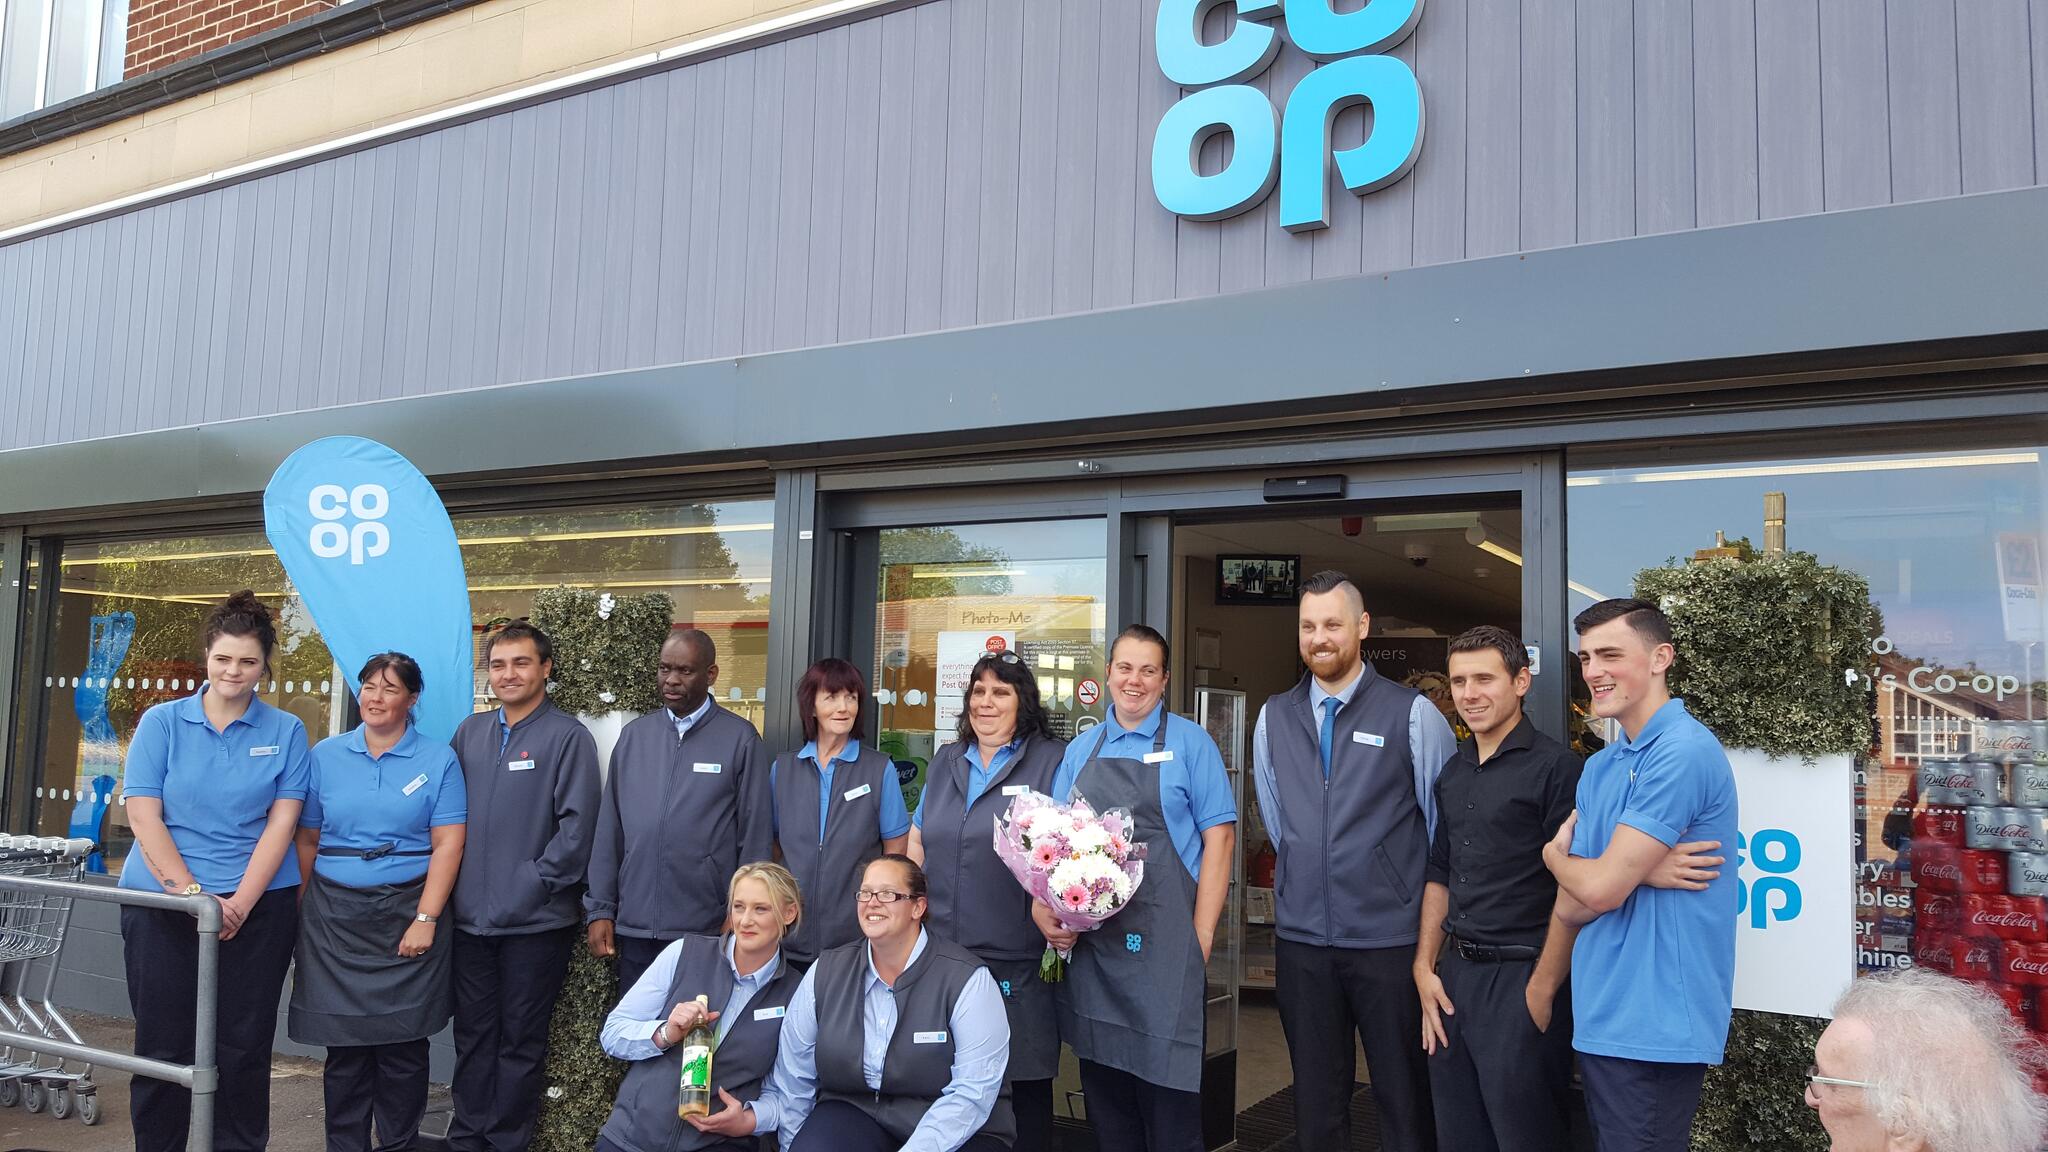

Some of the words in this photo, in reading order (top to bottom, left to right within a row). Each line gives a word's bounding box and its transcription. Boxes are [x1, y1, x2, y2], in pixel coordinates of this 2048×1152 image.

[961, 611, 1032, 625] Photo-Me
[942, 663, 974, 671] everything
[1907, 666, 2020, 702] Co-op
[1924, 773, 1949, 787] Diet
[1946, 774, 1976, 788] Coke
[2026, 776, 2048, 790] Die
[1975, 823, 2001, 836] Diet
[1999, 824, 2032, 838] Coke
[1738, 828, 1802, 874] o
[1738, 876, 1803, 930] p
[1854, 885, 1911, 909] bles
[1972, 909, 2032, 928] Coca-Cola
[1857, 944, 1913, 970] hine
[2010, 957, 2048, 976] Coca-C
